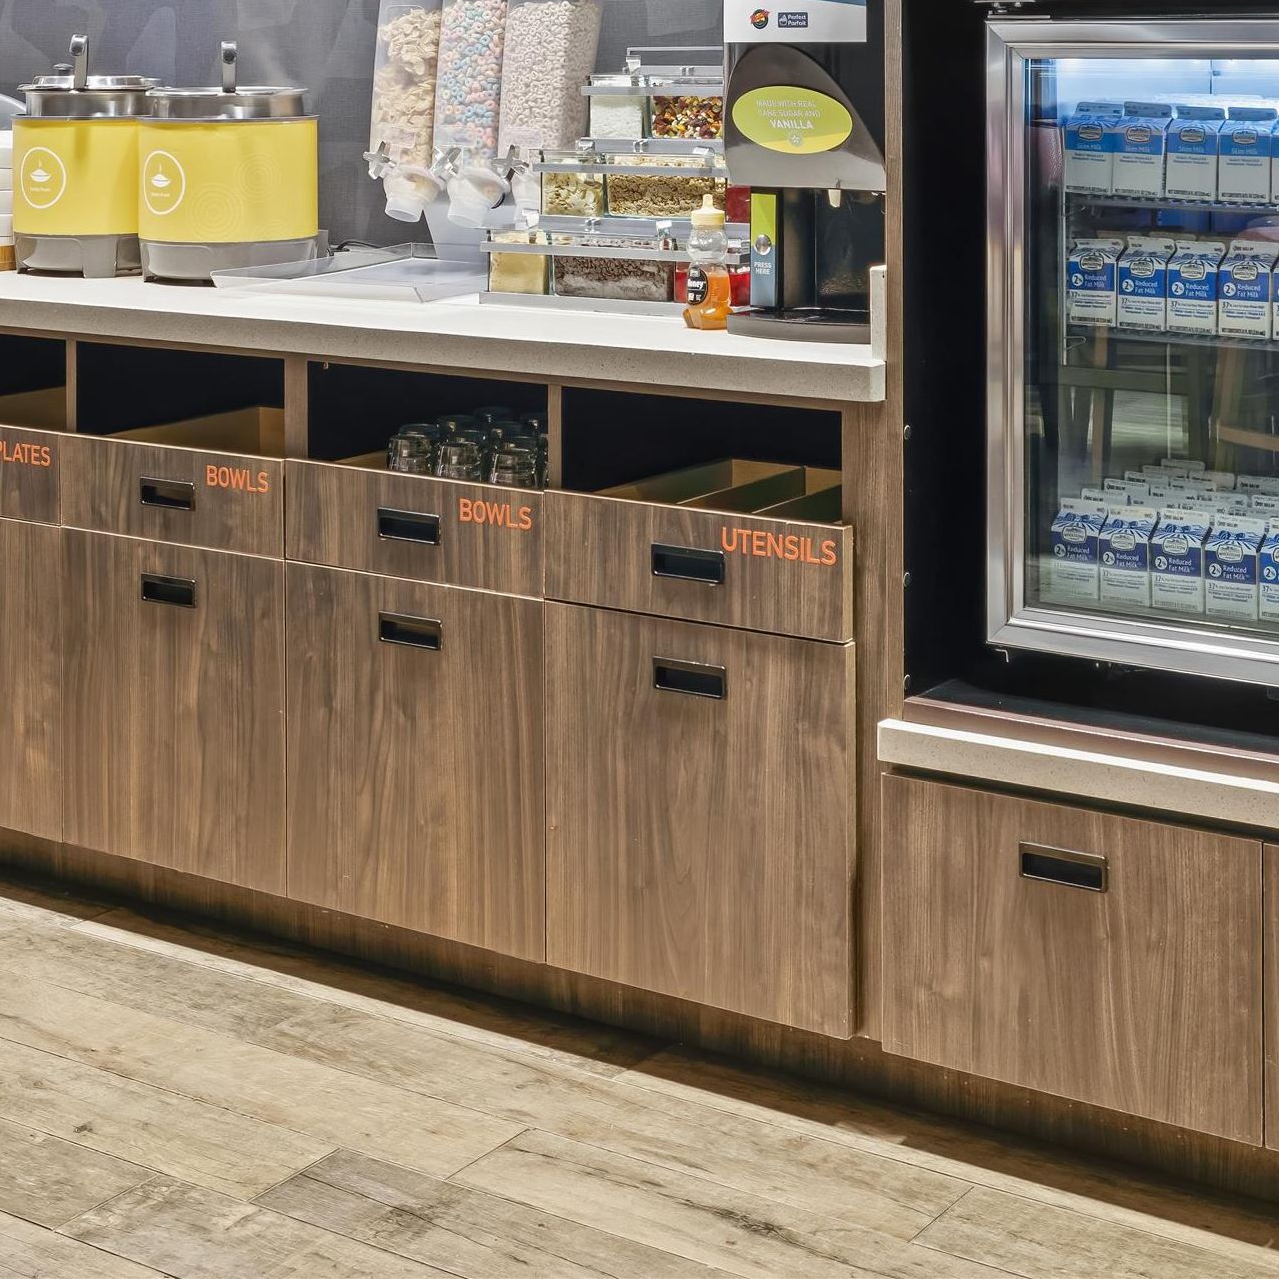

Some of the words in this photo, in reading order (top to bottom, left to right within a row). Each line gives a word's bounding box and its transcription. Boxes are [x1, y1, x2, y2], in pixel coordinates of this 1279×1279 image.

[770, 119, 814, 130] VANILLA
[206, 465, 269, 493] BOWLS
[459, 498, 532, 530] BOWLS
[722, 527, 837, 566] UTENSILS
